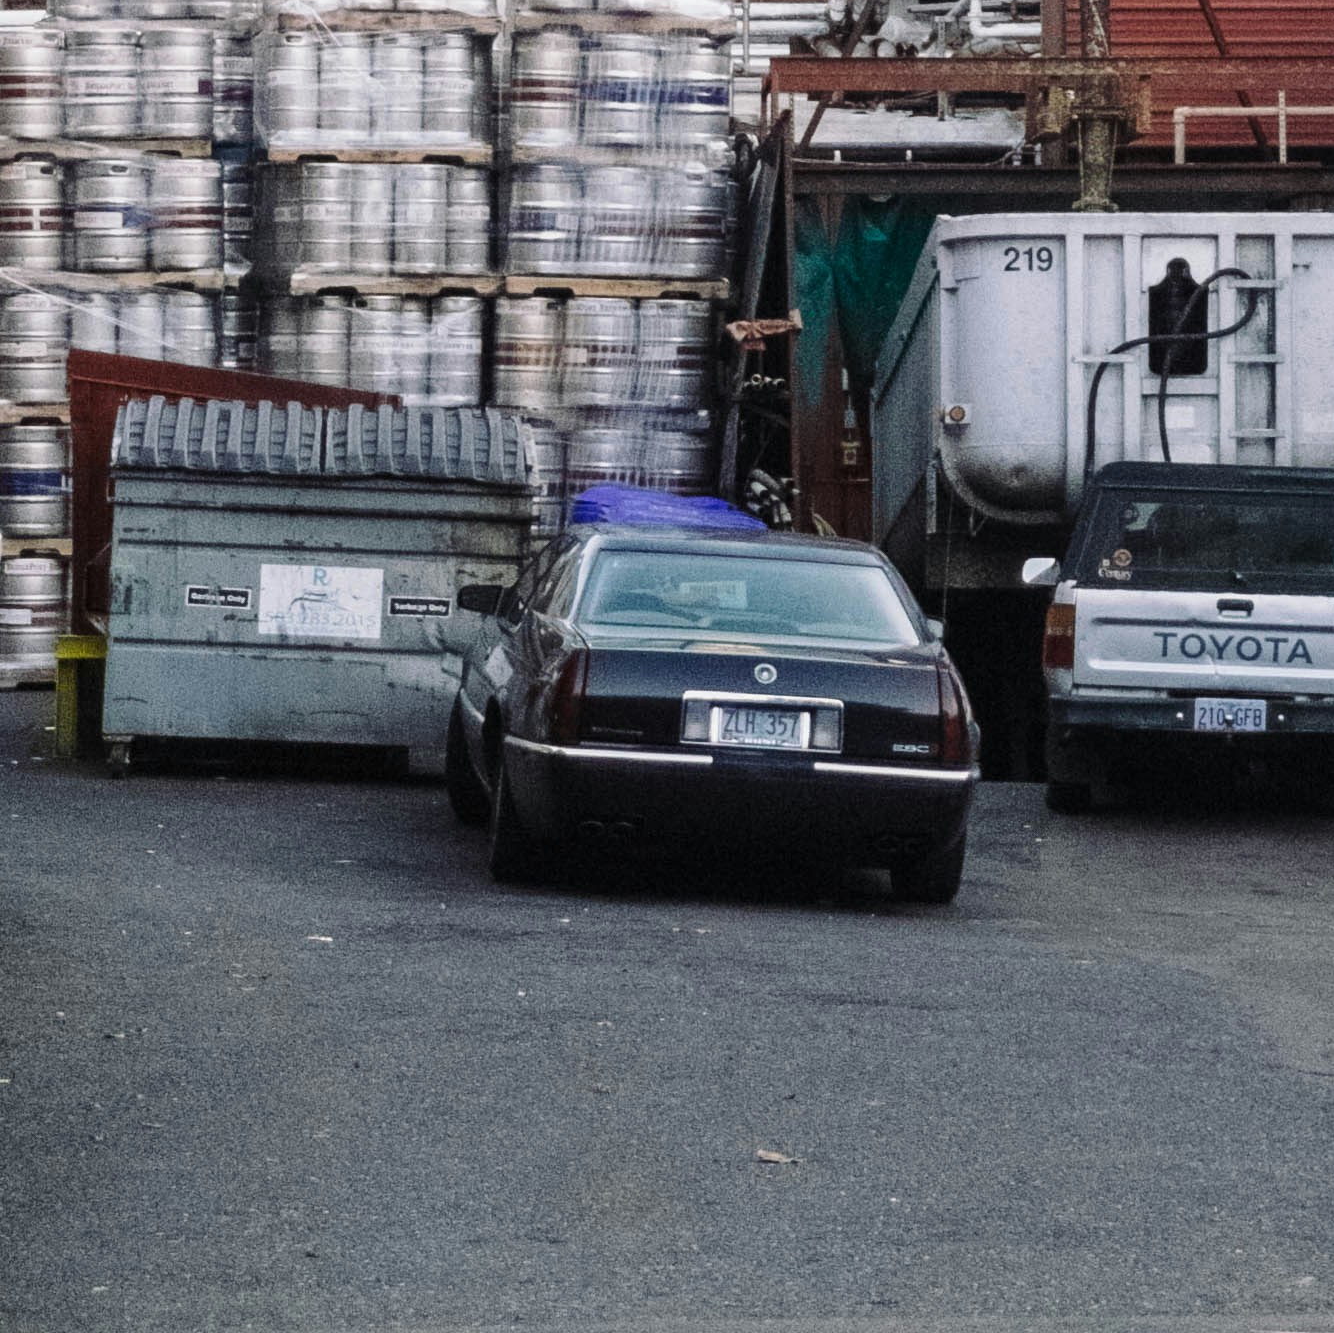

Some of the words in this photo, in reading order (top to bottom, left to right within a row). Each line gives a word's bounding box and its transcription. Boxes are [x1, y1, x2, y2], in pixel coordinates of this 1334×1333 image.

[1004, 246, 1054, 273] 219
[1154, 632, 1313, 665] TOYOTA
[723, 708, 756, 734] ZLH
[766, 713, 800, 739] 357
[1198, 706, 1226, 727] 210
